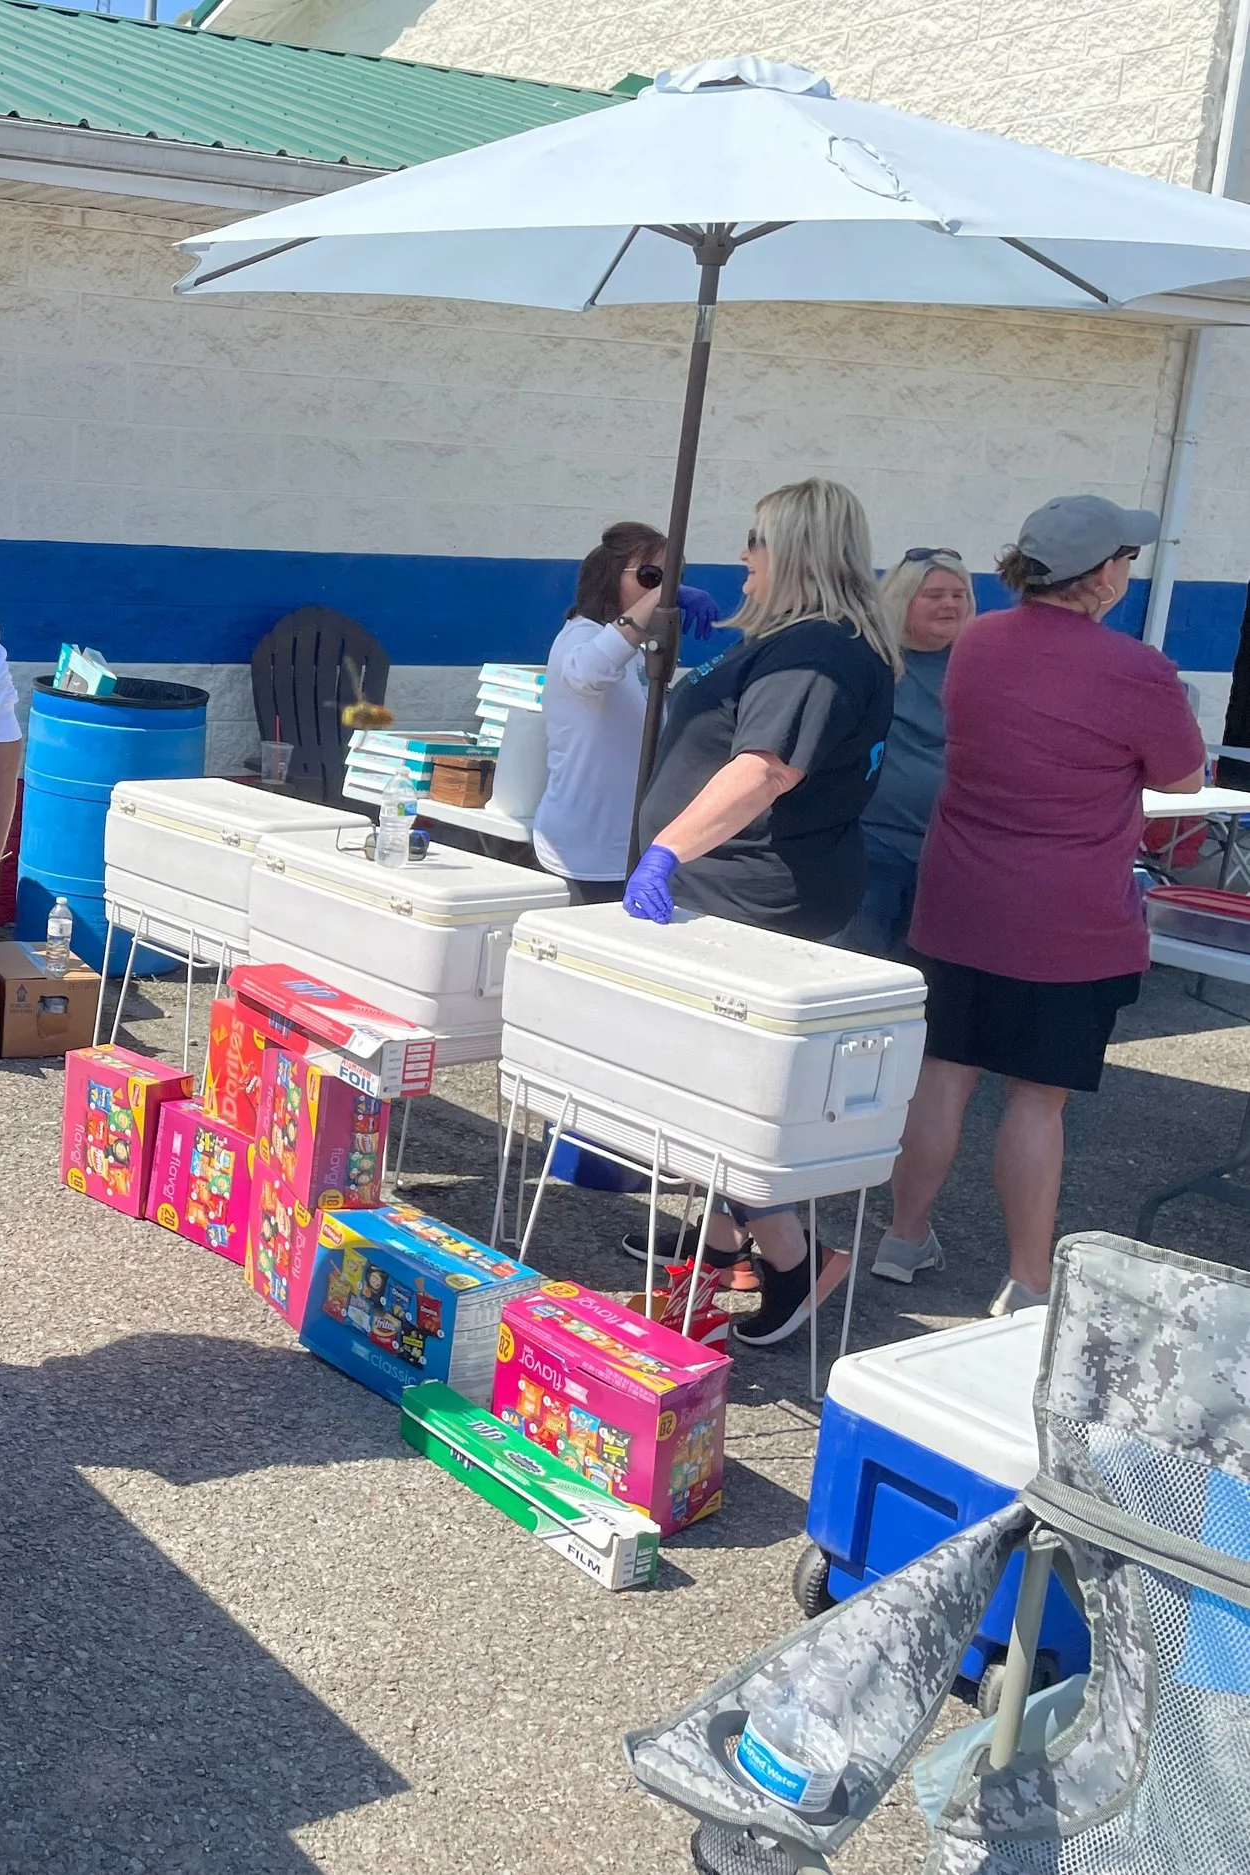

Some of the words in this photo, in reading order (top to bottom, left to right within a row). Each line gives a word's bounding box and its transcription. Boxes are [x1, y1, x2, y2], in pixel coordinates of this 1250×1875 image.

[222, 1019, 244, 1119] Doritos
[339, 1064, 375, 1096] FOIL
[72, 1124, 85, 1166] flavor
[166, 1156, 181, 1202] flavor
[328, 1147, 344, 1186] flavor
[577, 1297, 624, 1325] flavor
[368, 1351, 417, 1384] classic
[519, 1351, 563, 1392] flavor
[567, 1543, 602, 1576] FILM
[766, 1762, 799, 1790] Water
